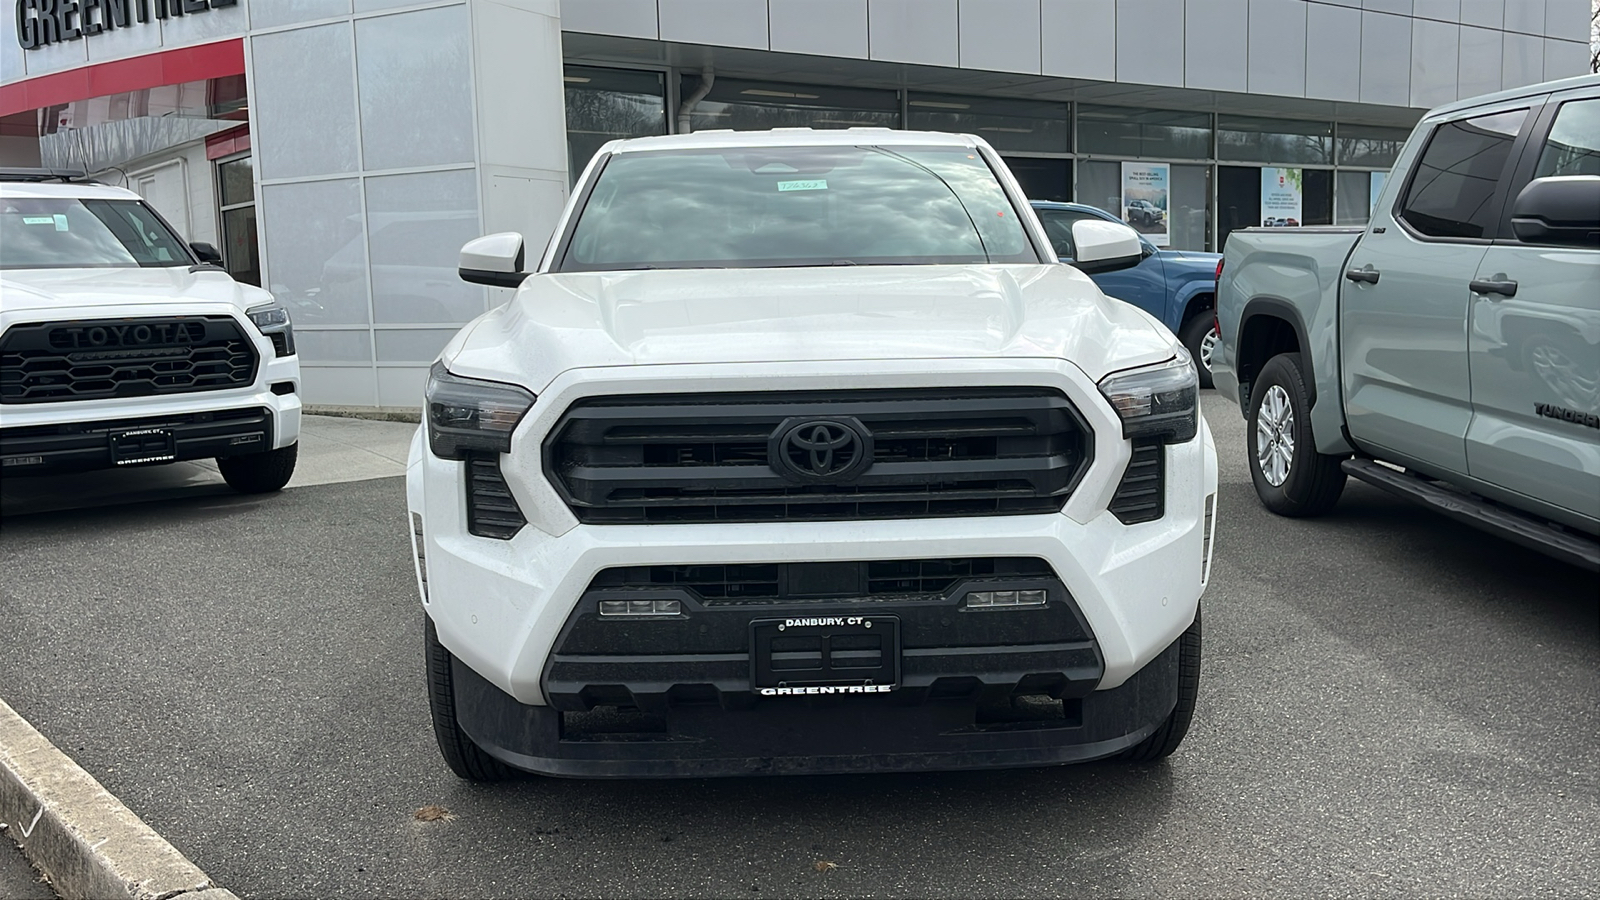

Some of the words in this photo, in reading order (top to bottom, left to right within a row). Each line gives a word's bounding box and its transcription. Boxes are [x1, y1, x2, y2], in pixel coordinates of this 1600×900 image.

[66, 322, 193, 348] TOYOTA
[1533, 402, 1600, 430] TUNDRA
[117, 455, 174, 465] GREENTREE
[785, 617, 845, 627] DANBURY,
[847, 616, 864, 625] CT
[760, 685, 892, 696] GREENTREE
